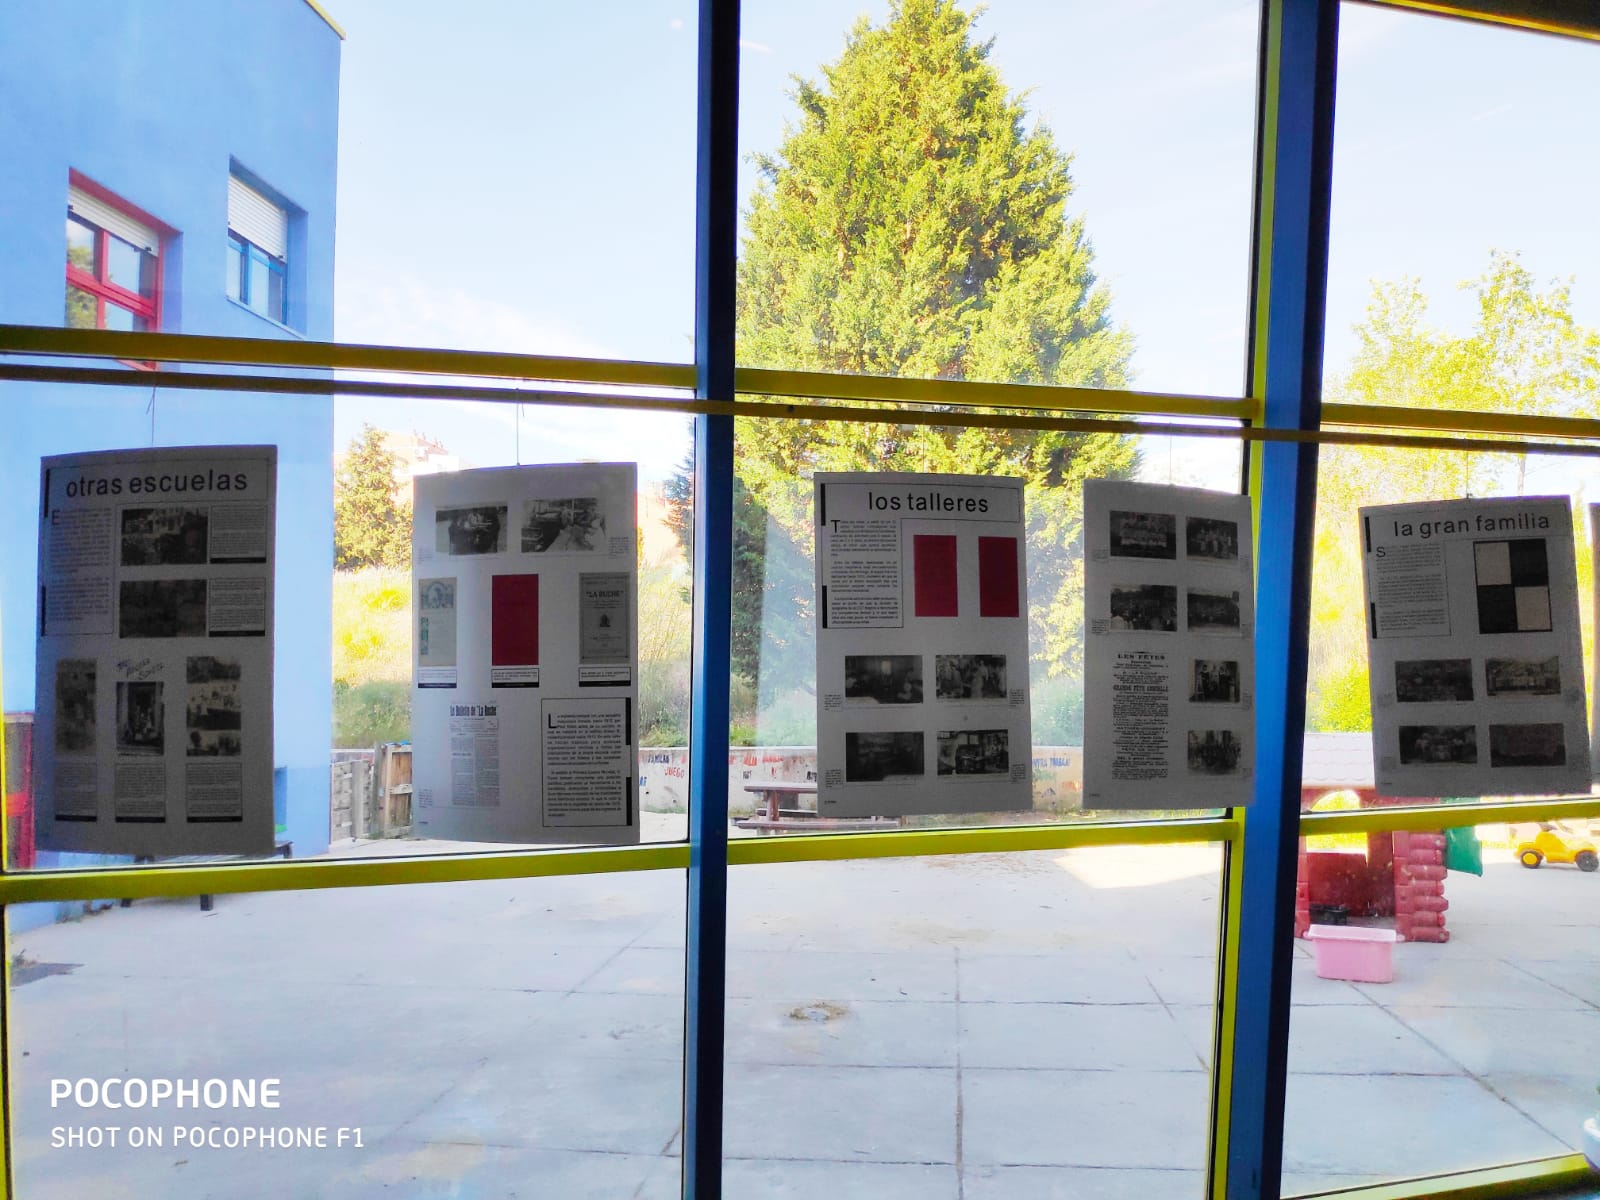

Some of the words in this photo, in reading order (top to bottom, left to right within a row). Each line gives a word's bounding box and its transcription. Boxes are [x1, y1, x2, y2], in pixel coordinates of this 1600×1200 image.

[66, 477, 122, 498] otras
[129, 469, 248, 494] escuelas
[868, 491, 901, 511] los
[907, 492, 989, 513] talleres
[1394, 520, 1413, 537] la
[1419, 520, 1470, 539] gran
[1475, 511, 1550, 532] familia
